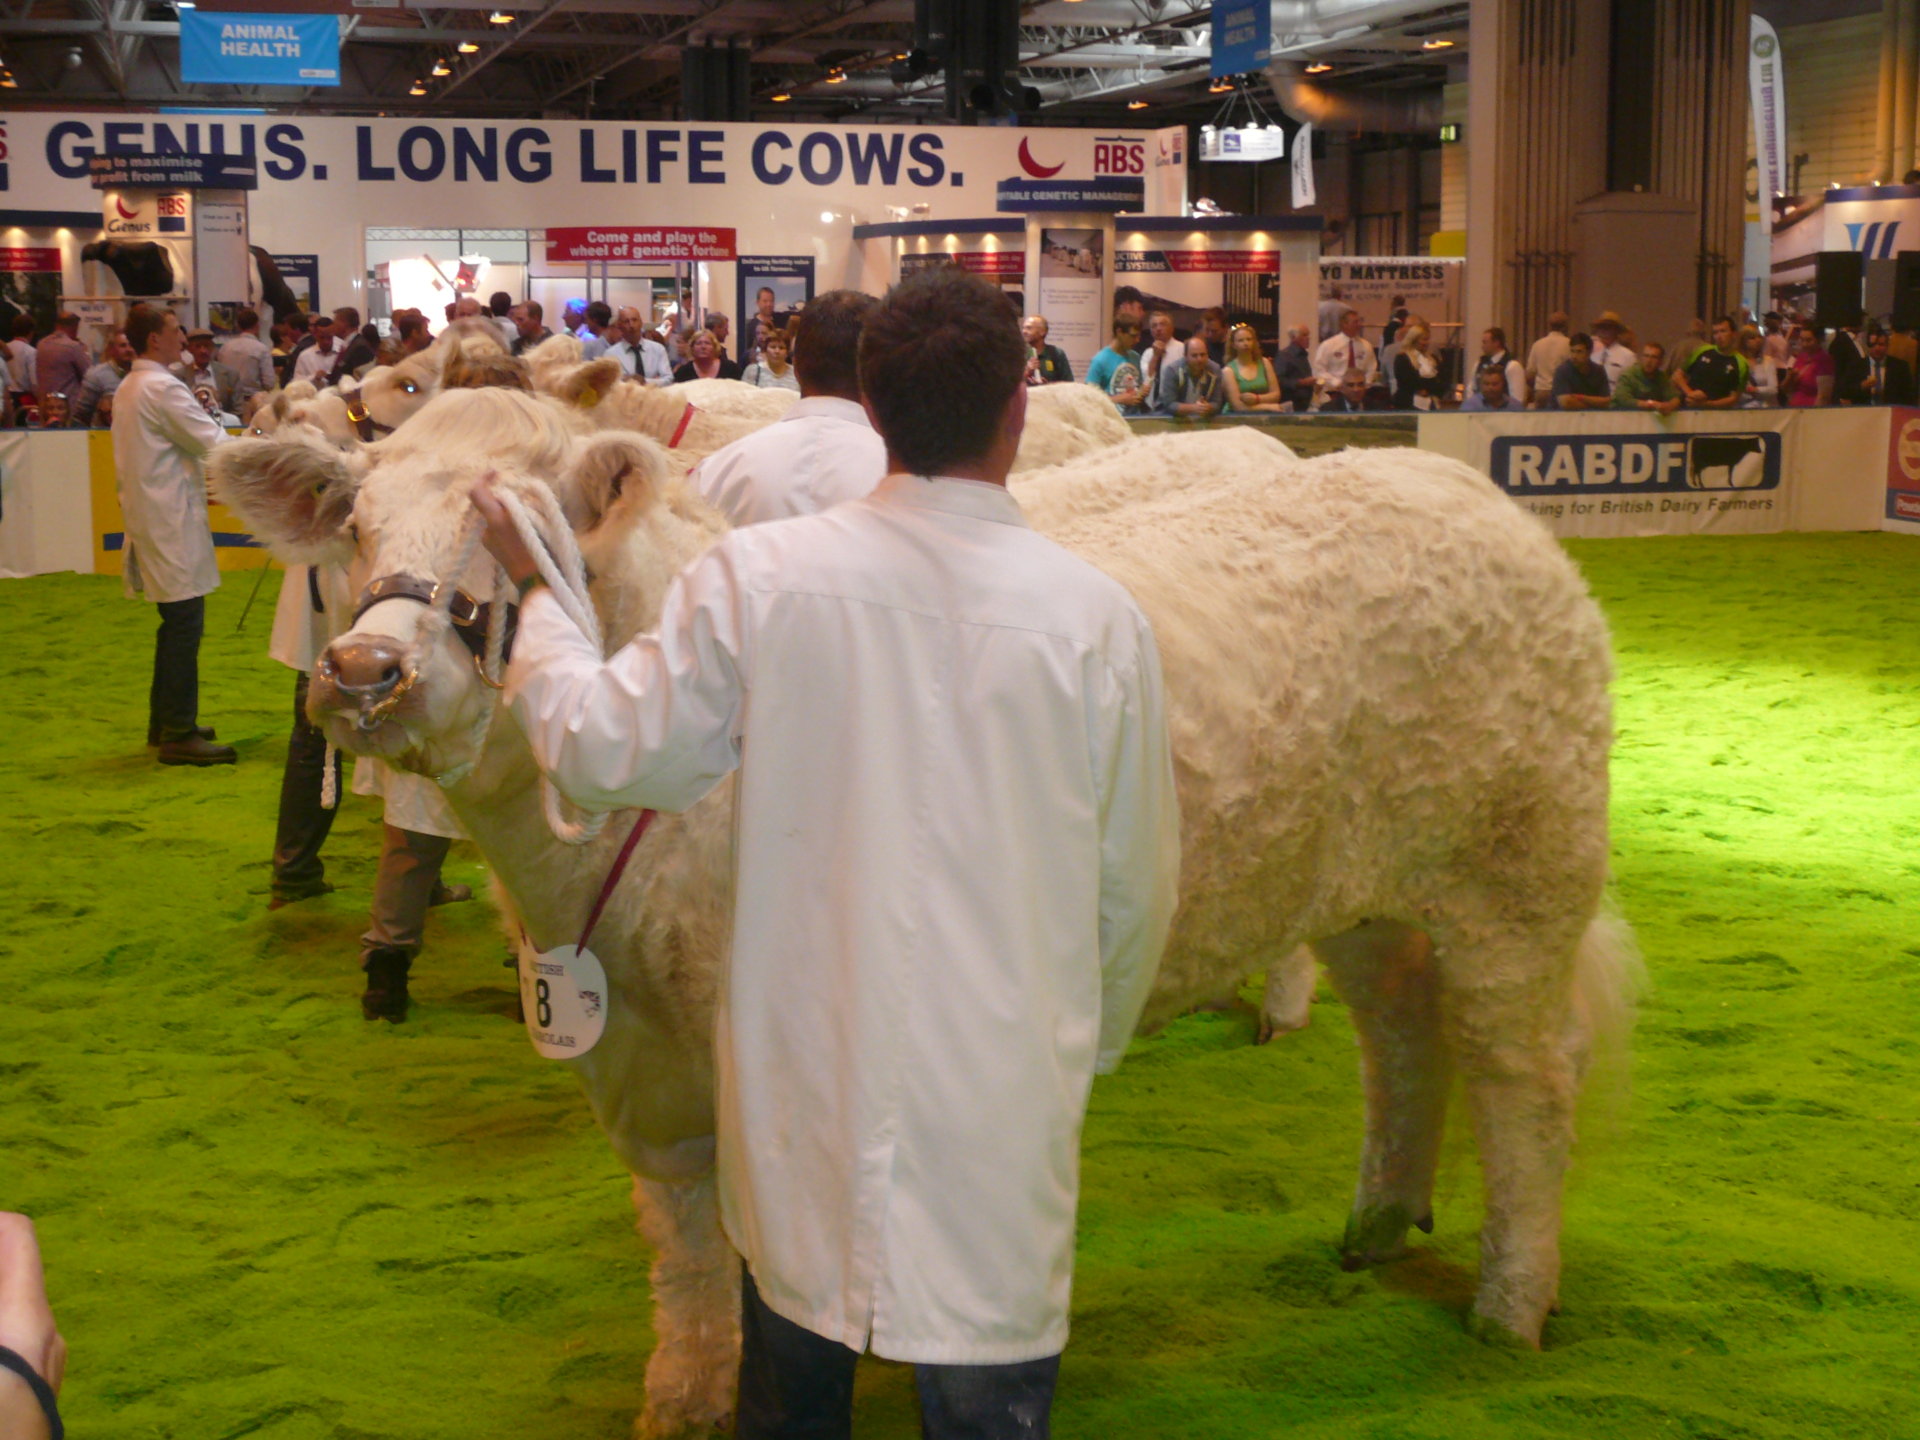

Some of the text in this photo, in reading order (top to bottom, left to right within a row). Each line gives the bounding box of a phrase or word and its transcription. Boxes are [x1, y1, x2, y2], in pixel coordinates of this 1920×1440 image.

[221, 24, 300, 40] ANIMAL
[221, 41, 301, 57] HEALTH
[46, 121, 328, 181] GENUS.
[357, 126, 552, 184] LONG
[580, 128, 726, 184] LIFE
[751, 131, 964, 187] COWS.
[114, 157, 127, 167] to
[130, 156, 203, 167] maximise
[1094, 144, 1145, 174] ABS
[132, 171, 166, 182] from
[170, 171, 203, 182] milk
[1032, 190, 1080, 201] GENETIC
[157, 198, 186, 215] ABS
[108, 219, 151, 232] Genus
[587, 231, 717, 246] Come and play the
[570, 245, 729, 258] wheel of genetic fortune
[1125, 261, 1166, 270] SYSTEMS
[1350, 265, 1444, 280] MATTRESS
[1508, 443, 1686, 487] RABDF
[1526, 497, 1773, 518] king for British Dairy Farmers
[536, 978, 552, 1028] 8
